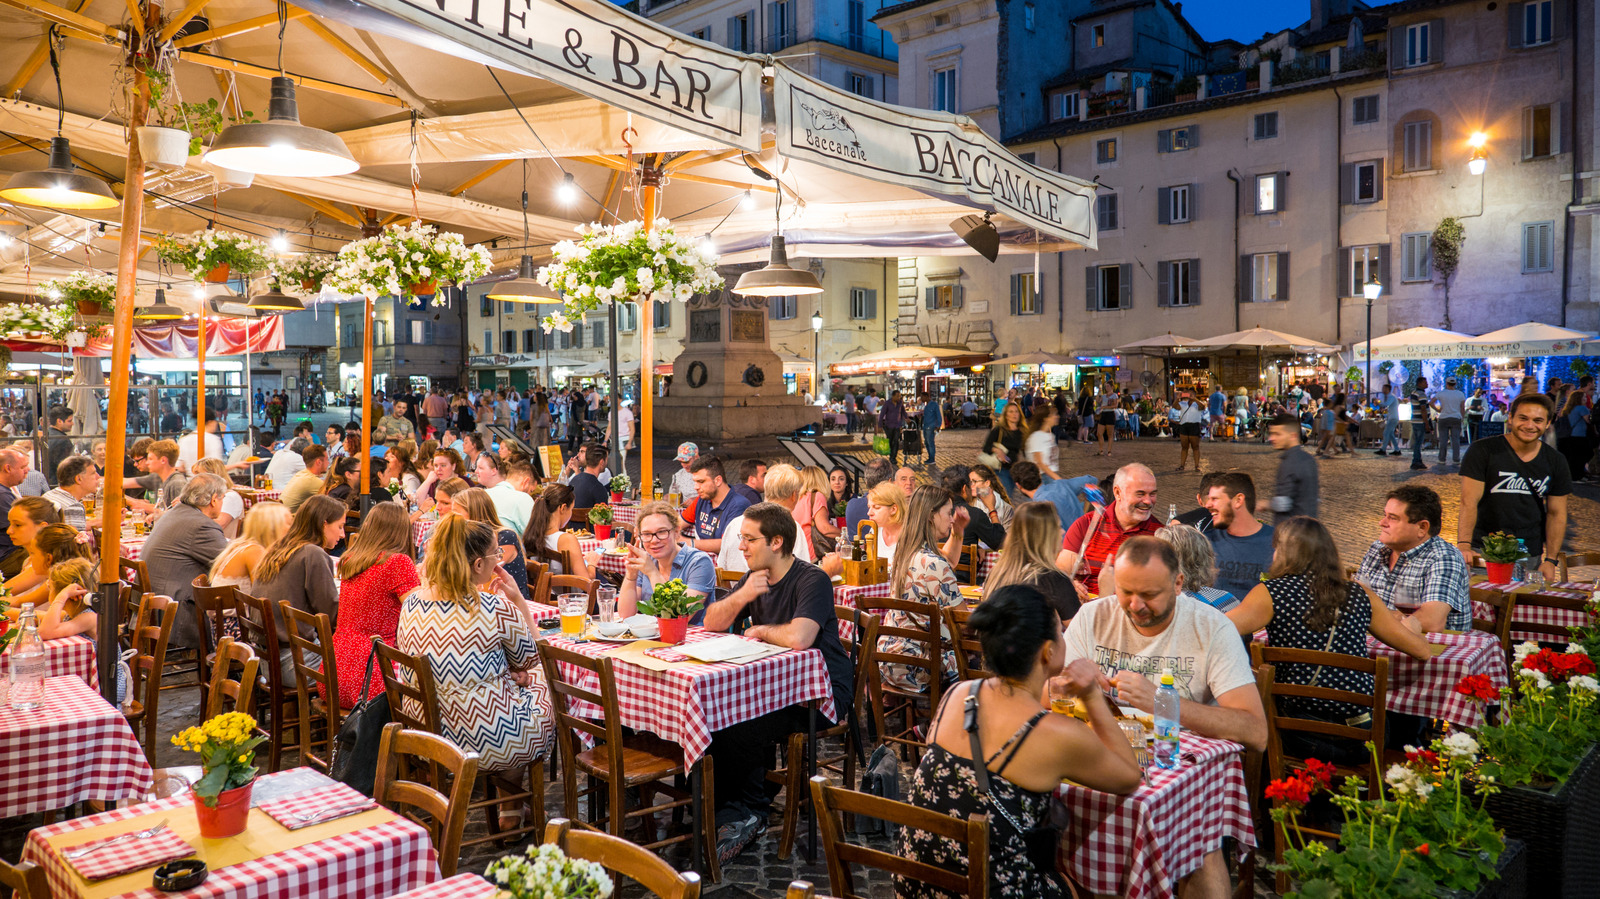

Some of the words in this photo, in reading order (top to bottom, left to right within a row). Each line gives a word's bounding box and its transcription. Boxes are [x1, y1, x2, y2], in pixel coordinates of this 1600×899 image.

[562, 27, 597, 75] &
[611, 30, 714, 120] BAR
[806, 128, 867, 161] Baccanale
[910, 132, 1062, 225] BACCANALE
[1407, 344, 1451, 352] OSTERIA
[1456, 344, 1476, 352] NEL
[1481, 343, 1520, 352] CAMPO
[1095, 645, 1120, 667] THE
